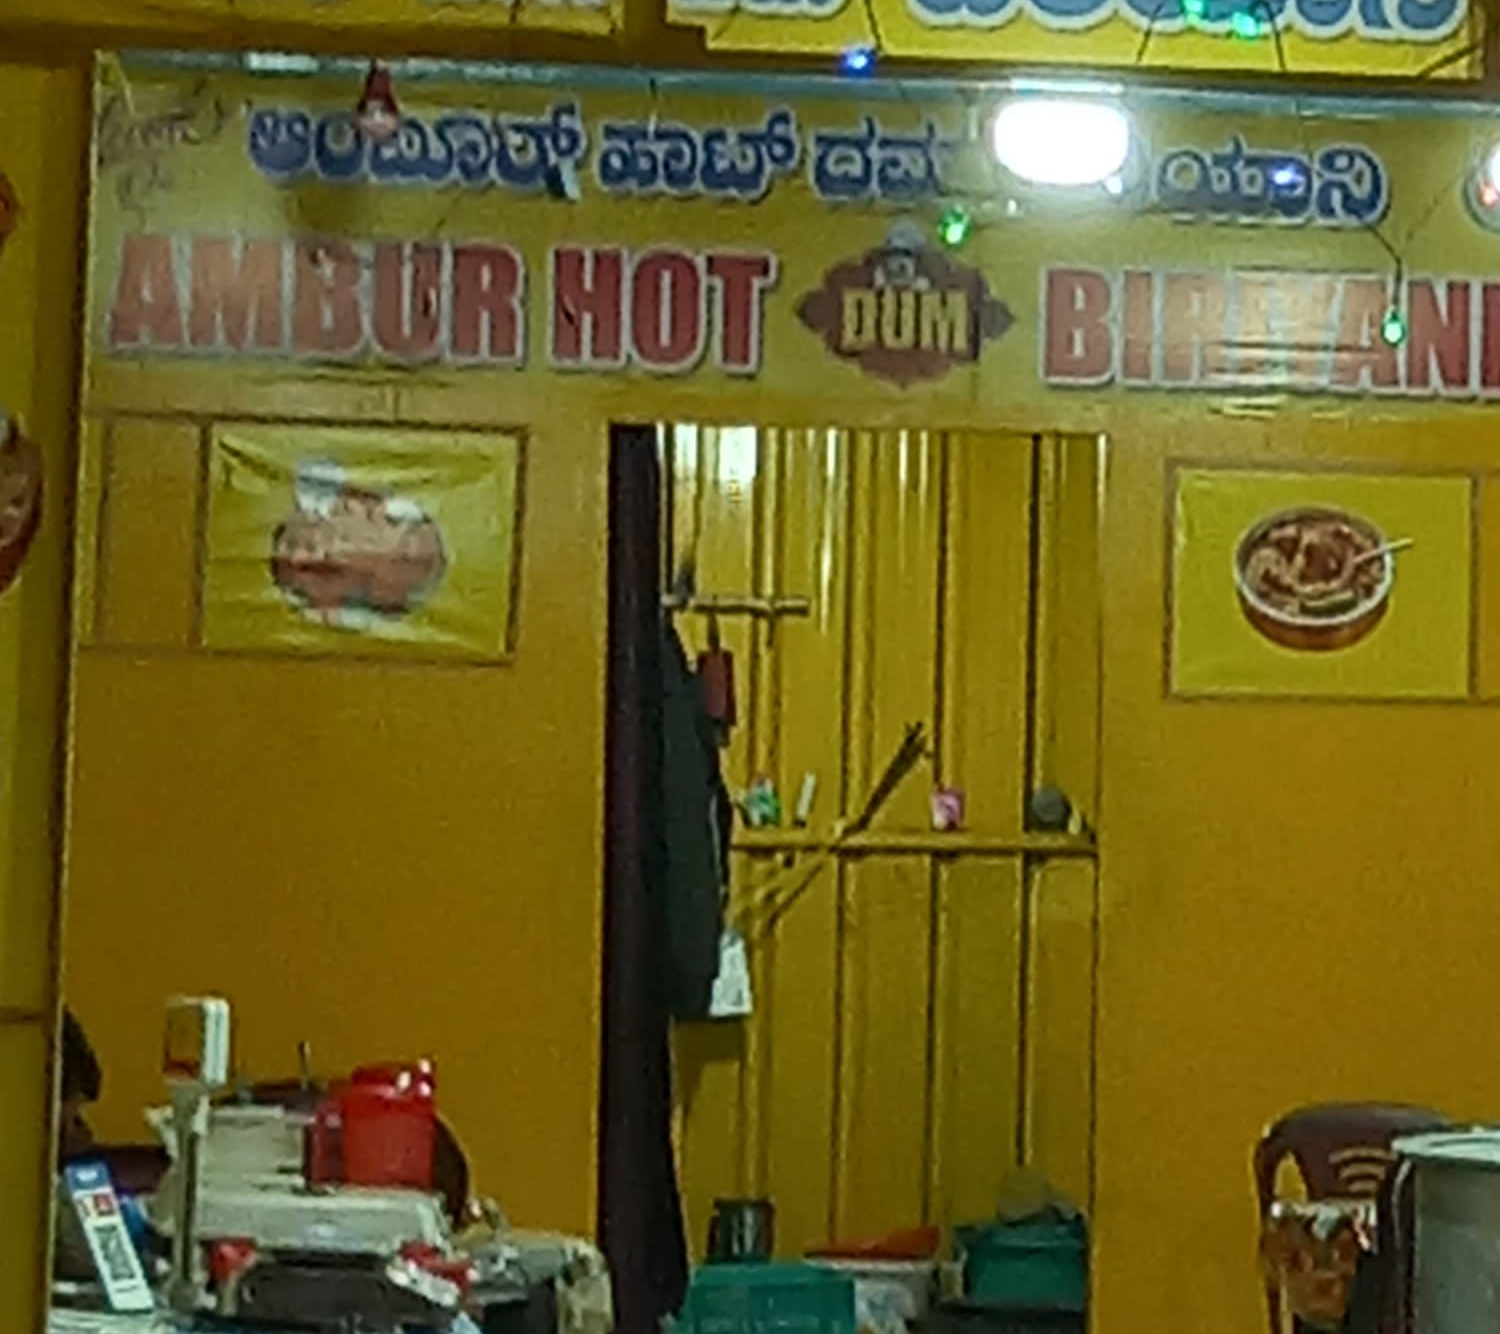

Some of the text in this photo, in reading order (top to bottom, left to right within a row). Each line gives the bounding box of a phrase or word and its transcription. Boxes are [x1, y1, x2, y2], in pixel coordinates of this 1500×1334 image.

[600, 111, 798, 196] ಹಾಟ್
[108, 235, 523, 361] AMBUR
[550, 247, 773, 367] HOT
[840, 287, 970, 354] DUM
